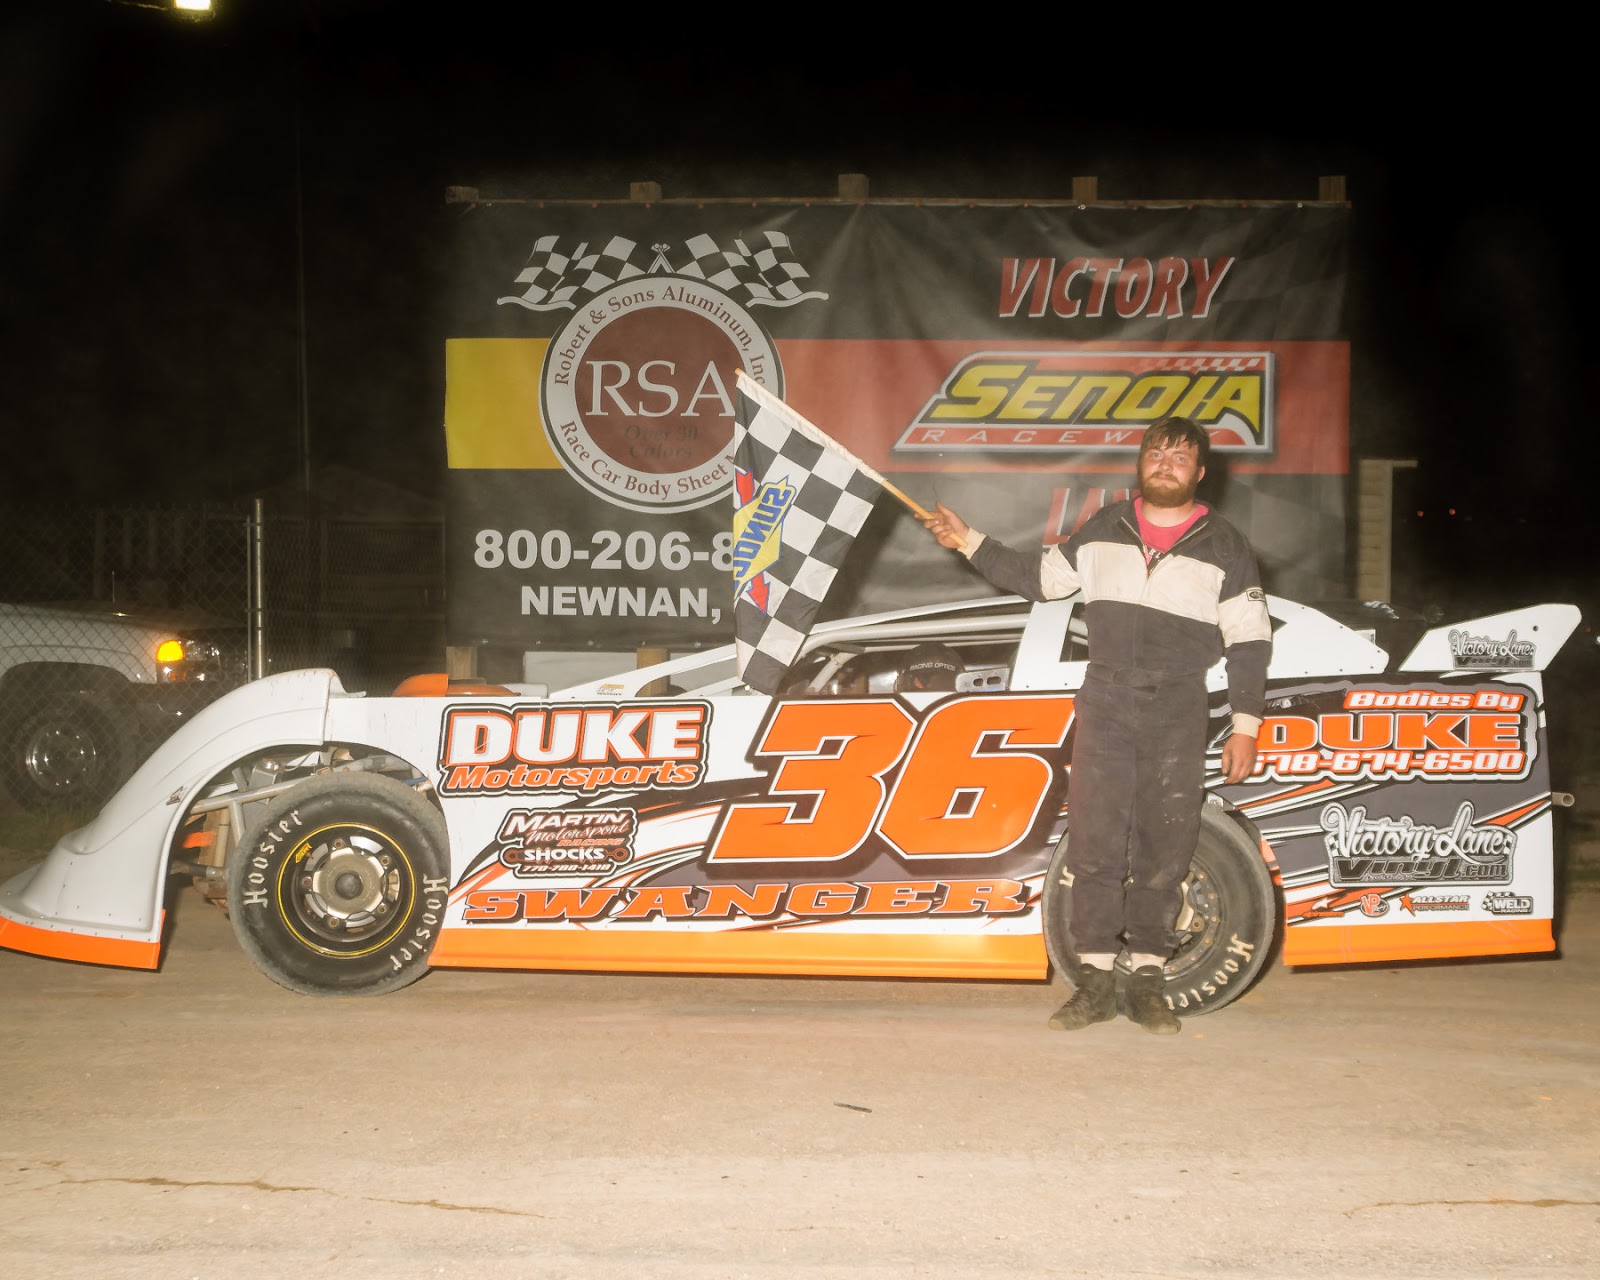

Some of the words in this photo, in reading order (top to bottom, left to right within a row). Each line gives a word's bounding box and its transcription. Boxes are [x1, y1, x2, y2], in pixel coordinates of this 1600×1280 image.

[999, 256, 1235, 319] VICTORY
[554, 324, 591, 386] Robert
[589, 309, 607, 325] &
[608, 290, 655, 313] Sons
[662, 285, 752, 352] Aluminum,
[585, 360, 736, 417] RSA
[929, 364, 1261, 433] SENOIA
[623, 425, 671, 441] Over
[629, 442, 693, 460] Colors
[920, 429, 1222, 444] RACEW
[560, 421, 591, 462] Race
[591, 458, 622, 485] Car
[624, 474, 671, 501] Body
[677, 463, 729, 495] Sheet
[474, 528, 735, 571] 800-206-8
[520, 585, 722, 624] NEWNAN,
[1450, 631, 1500, 659] Victory
[1499, 630, 1531, 660] Lane
[934, 662, 956, 671] OPTICS
[1349, 691, 1472, 708] Bodies
[1474, 691, 1521, 711] By
[447, 706, 705, 766] DUKE
[1256, 713, 1522, 752] DUKE
[446, 761, 700, 791] Motorsports
[707, 696, 1077, 864] 36
[502, 812, 629, 837] MARTIN
[556, 837, 626, 848] RACING
[1322, 805, 1436, 863] Victory
[1434, 803, 1507, 866] Lane
[243, 809, 304, 908] Hoosier
[523, 847, 606, 862] SHOCKS
[462, 878, 1028, 921] SWANGER
[1360, 893, 1381, 917] VP
[1412, 894, 1470, 903] ALLSTAR
[1493, 898, 1531, 910] WELD
[389, 874, 449, 971] Hoosier
[1164, 933, 1255, 1011] Hoosier
